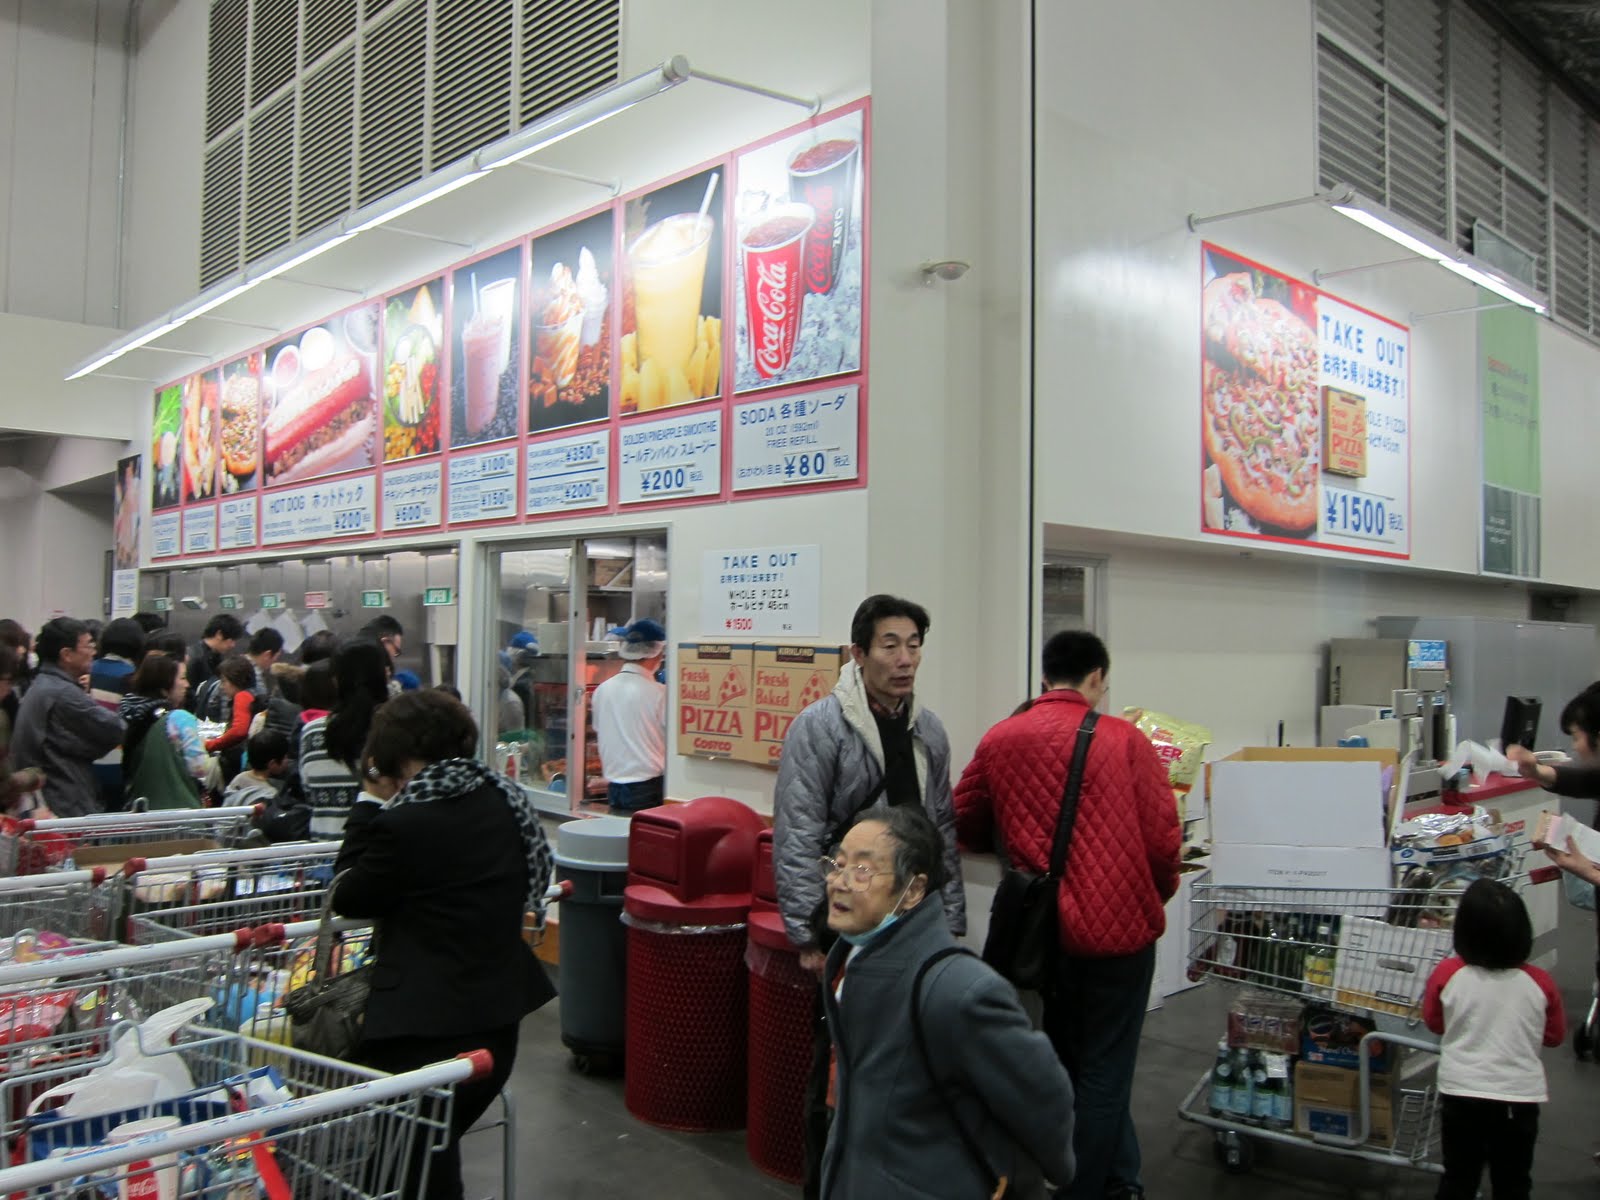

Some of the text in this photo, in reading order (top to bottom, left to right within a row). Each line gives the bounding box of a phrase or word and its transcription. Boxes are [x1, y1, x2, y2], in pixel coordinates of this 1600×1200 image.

[1322, 314, 1405, 369] TAKE OUT
[740, 392, 848, 425] SODA 各種ソーダ
[767, 434, 819, 448] FREE REFILL
[566, 445, 593, 462] ¥350
[784, 452, 824, 478] ¥80
[641, 468, 684, 491] ¥200
[565, 483, 592, 499] ¥200
[334, 511, 361, 529] ¥200
[1325, 490, 1385, 536] ¥1500
[723, 552, 798, 569] TAKE OUT
[729, 589, 790, 600] WHOLE PIZZA
[767, 600, 789, 610] 45cm
[726, 618, 752, 630] ¥1500
[680, 705, 743, 735] PIZZA
